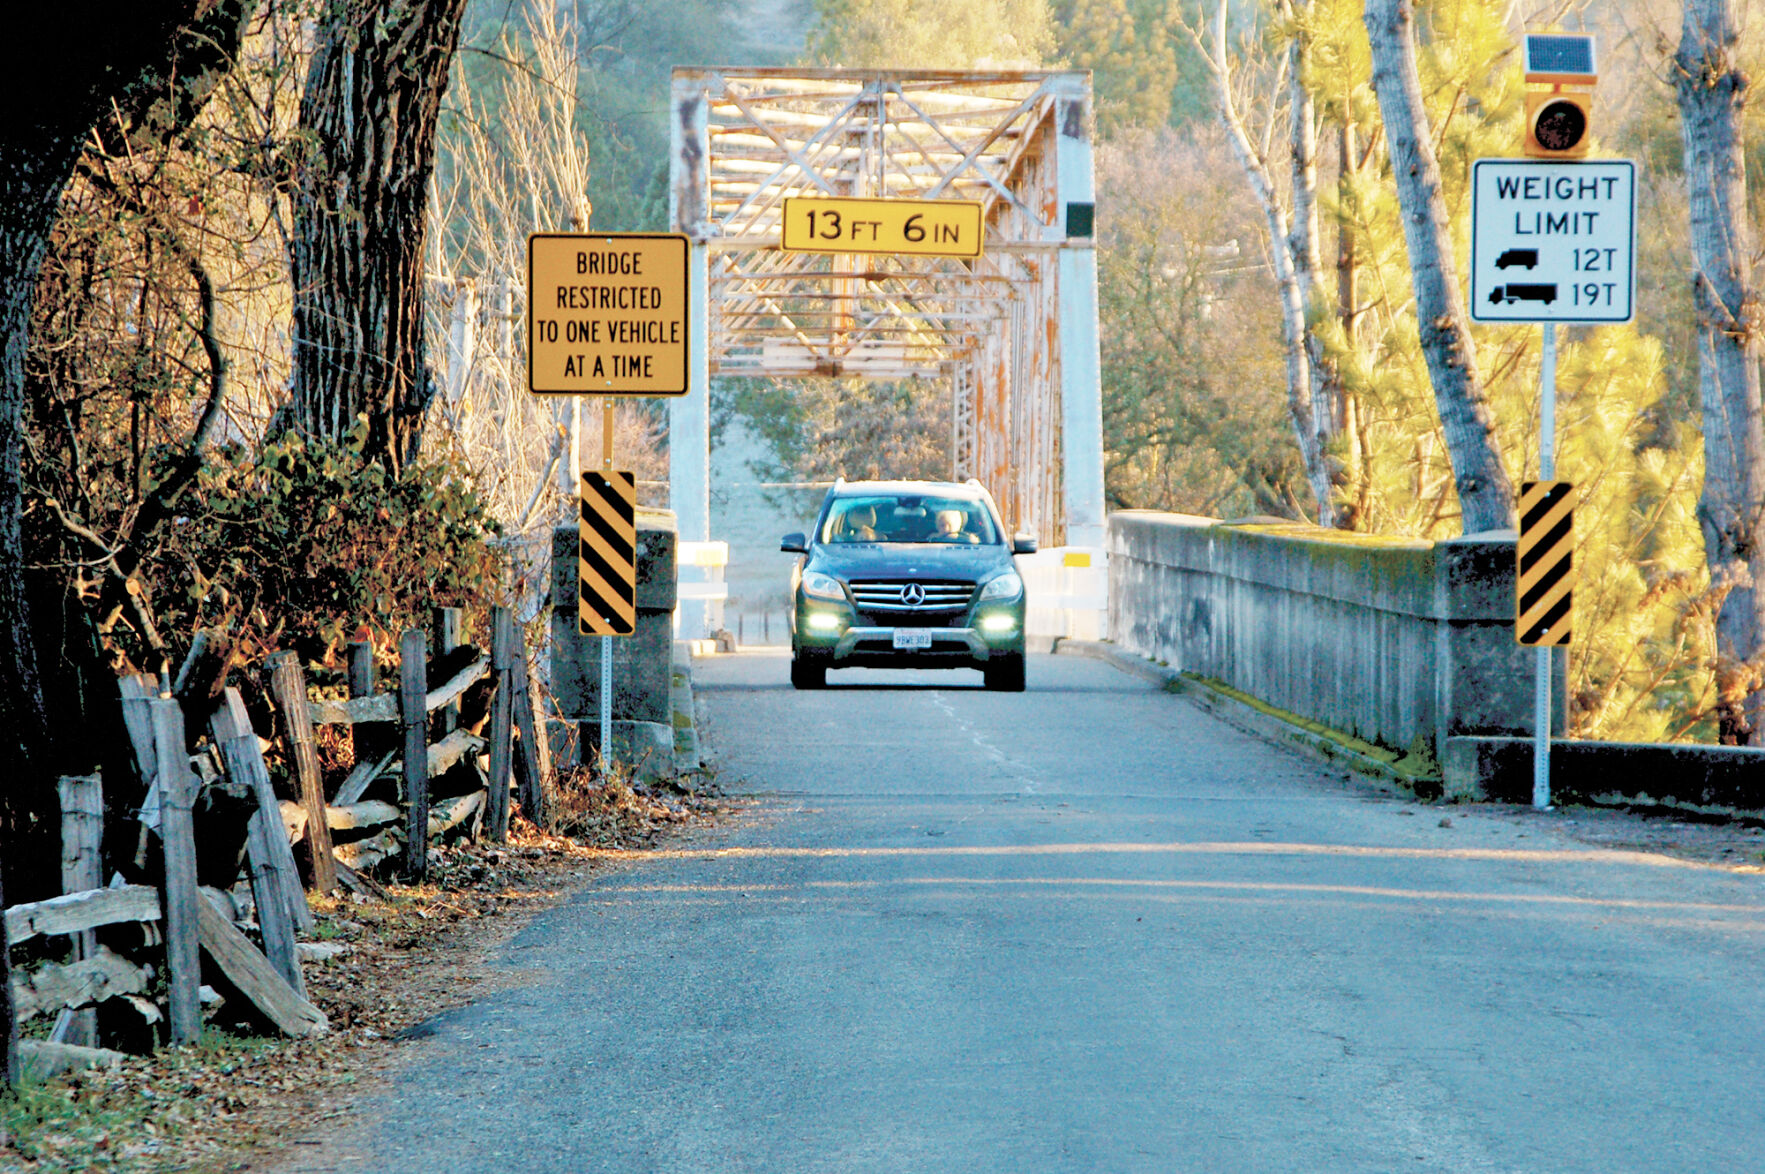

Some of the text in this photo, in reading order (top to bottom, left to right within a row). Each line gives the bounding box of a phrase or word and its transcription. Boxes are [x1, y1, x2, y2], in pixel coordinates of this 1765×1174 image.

[1496, 176, 1619, 200] WEIGHT
[807, 209, 960, 244] 13 FT 6 IN
[1515, 211, 1600, 235] LIMIT
[576, 251, 643, 275] BRIDGE
[1573, 248, 1618, 272] 12T
[556, 285, 662, 310] RESTRICTED
[1573, 283, 1617, 306] 19T
[537, 320, 680, 344] TO ONE VEHICLE
[564, 354, 653, 378] AT A TIME
